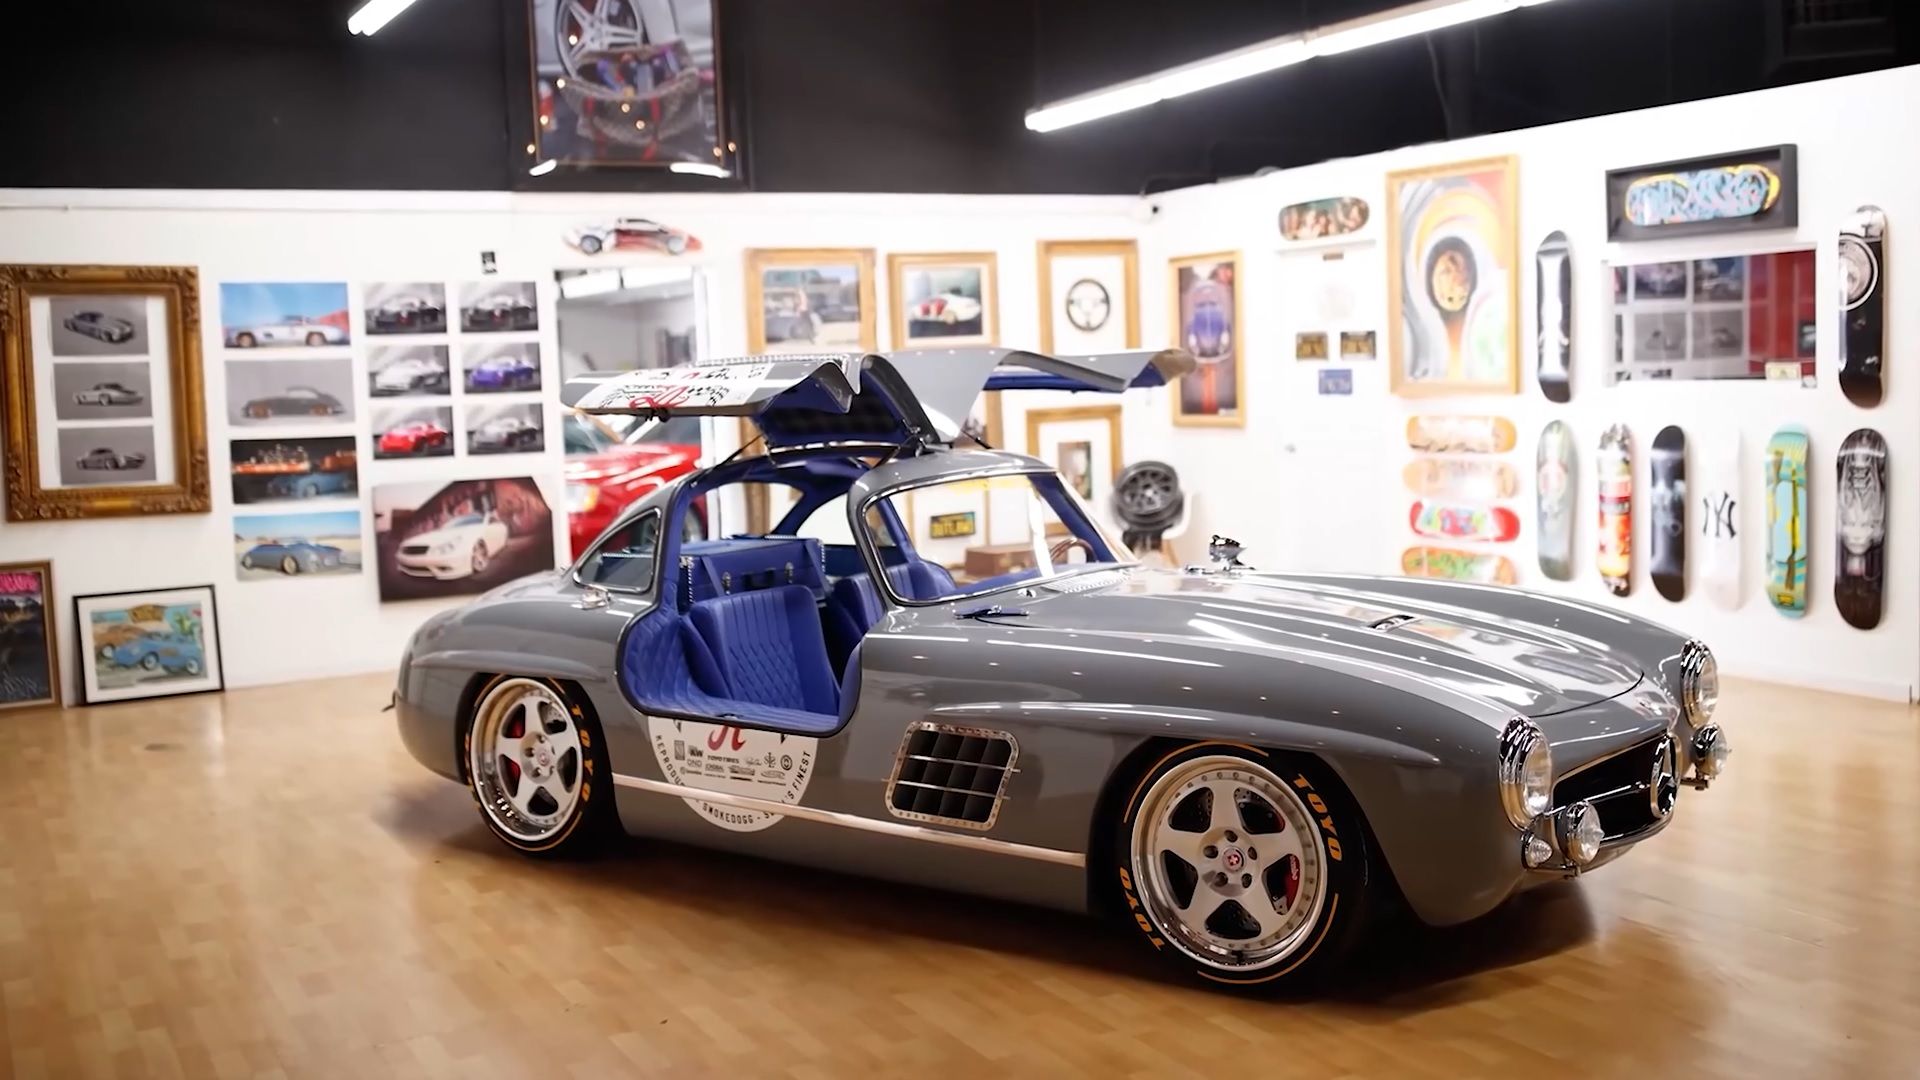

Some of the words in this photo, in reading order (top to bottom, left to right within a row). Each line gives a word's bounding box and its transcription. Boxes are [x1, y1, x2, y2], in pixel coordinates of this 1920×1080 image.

[571, 704, 594, 802] TOYO
[791, 750, 811, 791] FINEST
[702, 802, 754, 825] SMOKEDOGG
[1292, 773, 1343, 861] TOYO
[1119, 866, 1165, 951] TOYO
